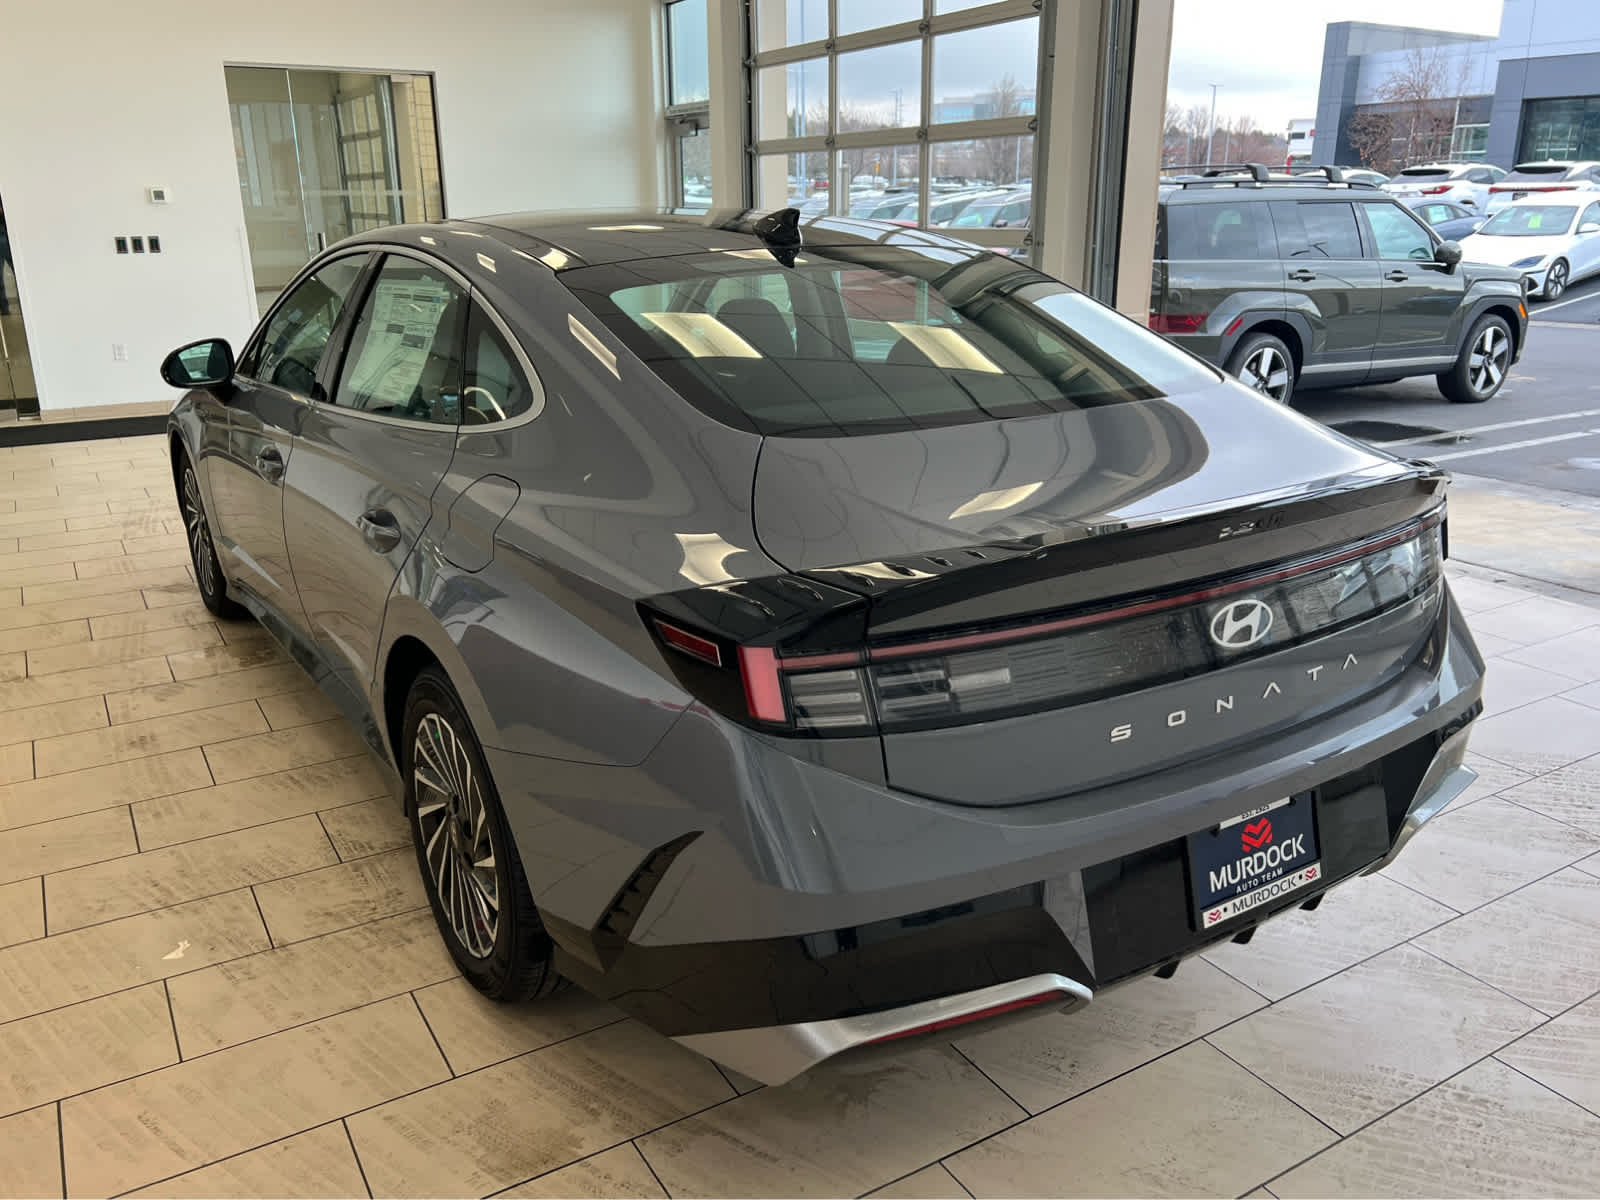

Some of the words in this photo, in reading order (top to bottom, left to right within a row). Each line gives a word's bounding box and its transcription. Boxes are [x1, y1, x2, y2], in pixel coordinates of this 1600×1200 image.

[1110, 653, 1358, 743] SONATA
[1209, 833, 1306, 893] MURDOCK
[1236, 878, 1259, 894] AUTO
[1262, 867, 1283, 884] TEAM
[1232, 876, 1297, 914] MURDOCK
